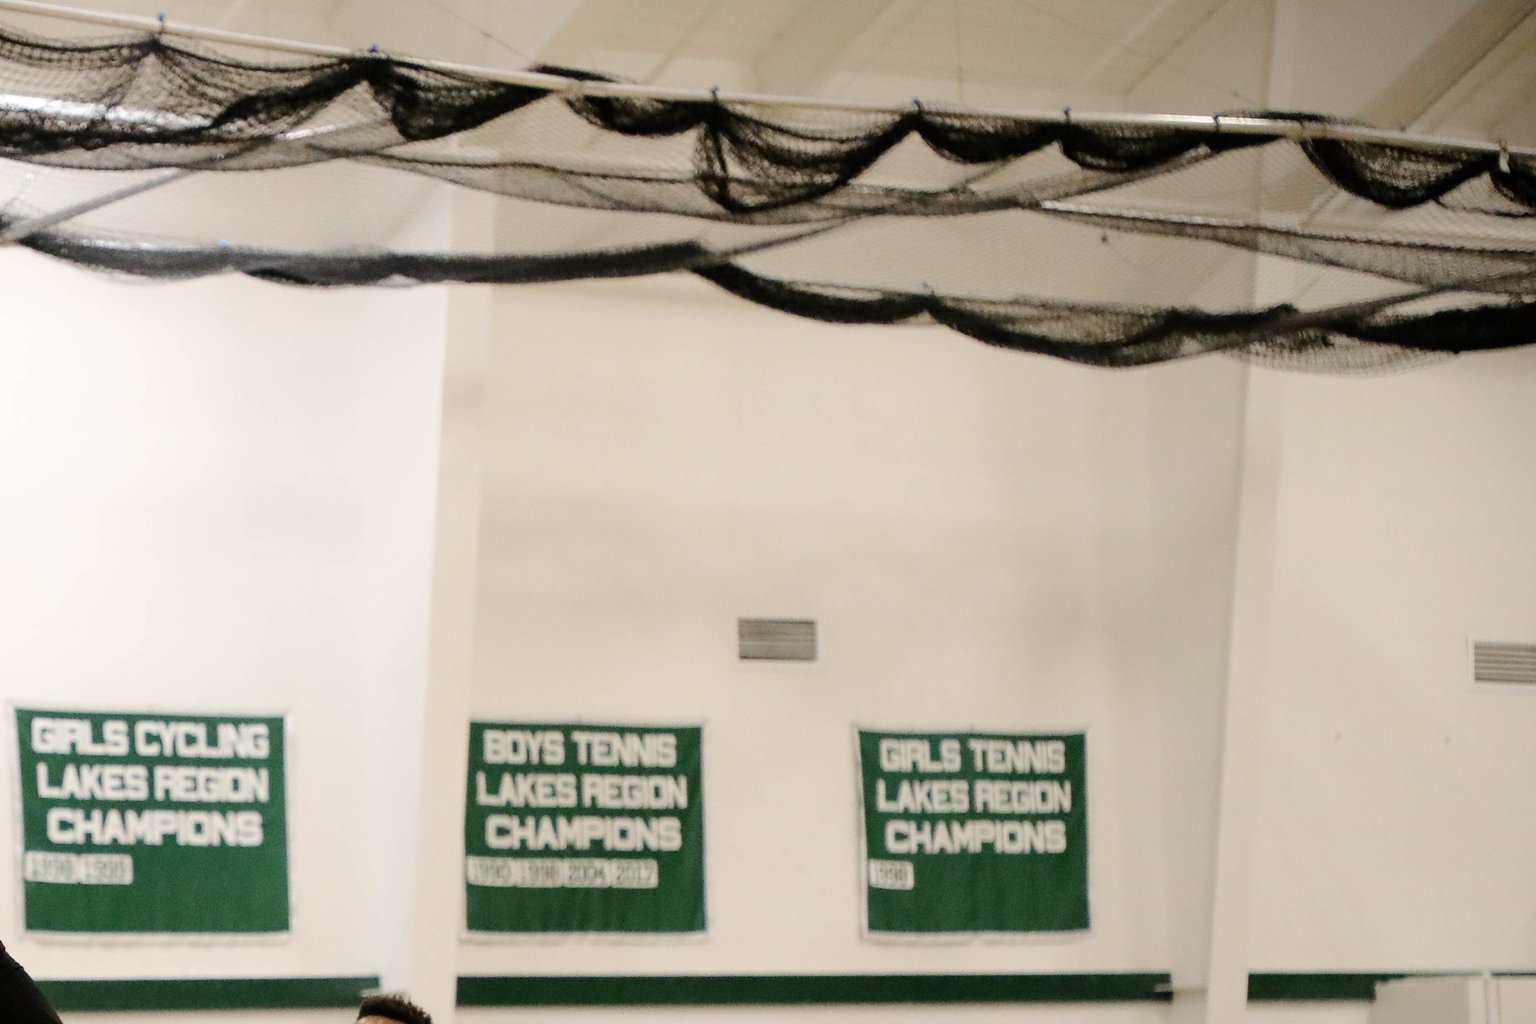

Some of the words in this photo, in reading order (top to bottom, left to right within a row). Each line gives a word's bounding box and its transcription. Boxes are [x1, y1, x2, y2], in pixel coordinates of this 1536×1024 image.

[31, 717, 130, 757] GIRLS
[134, 720, 270, 760] CYCLING
[483, 729, 565, 766] BOYS
[571, 731, 677, 768] TENNIS
[879, 738, 962, 773] GIRLS
[968, 740, 1066, 775] TENNIS
[36, 762, 149, 801] LAKES
[153, 765, 270, 804] REGION
[476, 770, 578, 808] LAKES
[581, 773, 688, 809] REGION
[875, 778, 970, 813] LAKES
[974, 779, 1072, 815] REGION
[46, 807, 264, 847] CHAMPIONS
[484, 814, 682, 852] CHAMPIONS
[884, 818, 1067, 855] CHAMPIONS
